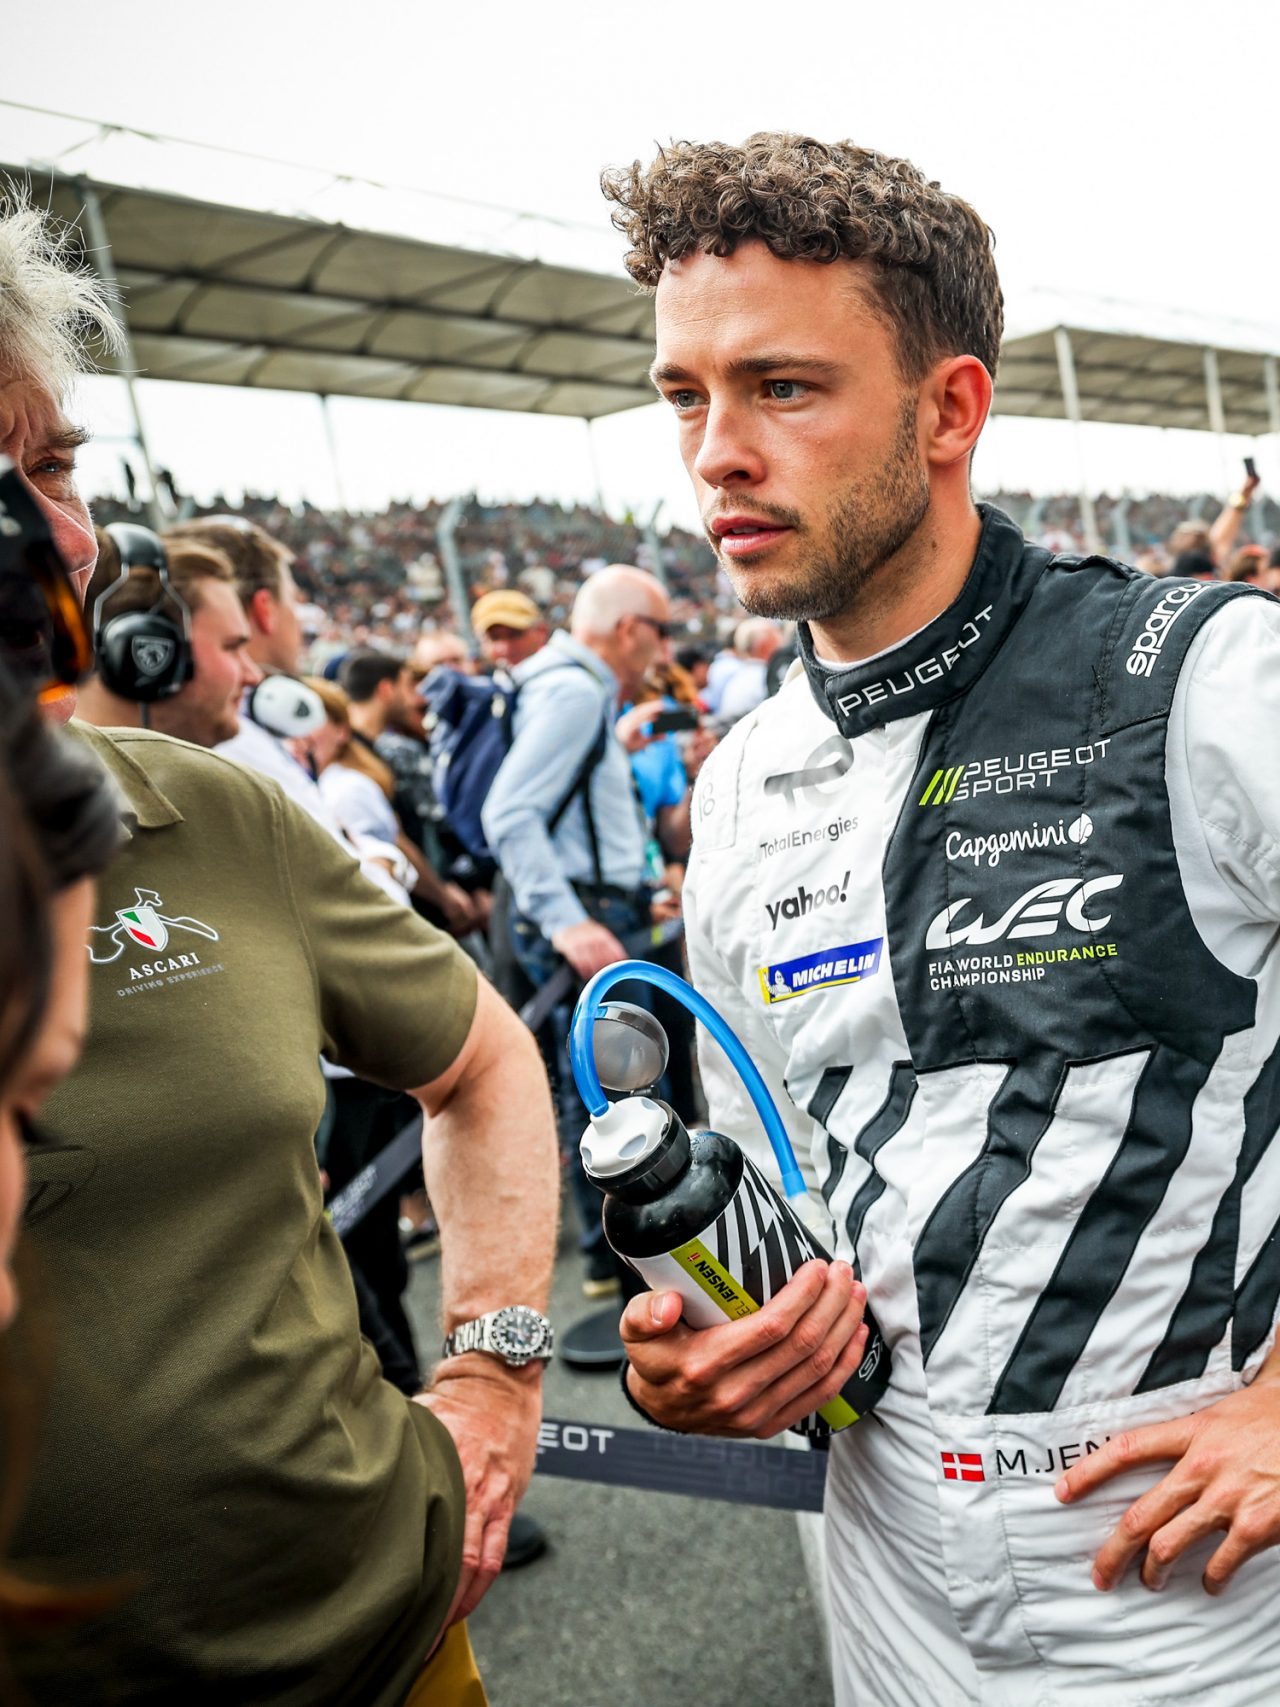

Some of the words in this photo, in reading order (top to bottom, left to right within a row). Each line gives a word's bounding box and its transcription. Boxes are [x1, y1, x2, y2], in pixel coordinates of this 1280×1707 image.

[1126, 582, 1204, 678] sparco
[962, 738, 1112, 781] PEUGEOT
[952, 769, 1059, 802] SPORT
[759, 816, 859, 859] TotalEnergies
[945, 819, 1067, 868] Capgemini
[765, 870, 852, 931] yahoo!
[925, 874, 1124, 951] WEC
[117, 979, 165, 998] DRIVING
[166, 964, 225, 984] EXPERIENCE
[129, 952, 201, 980] ASCARI
[791, 952, 877, 988] MICHELIN
[929, 957, 955, 976] FIA
[953, 954, 1014, 972] WORLD
[1016, 943, 1118, 967] ENDURANCE
[930, 967, 1046, 991] CHAMPIONSHIP
[695, 1260, 740, 1303] JENSEN
